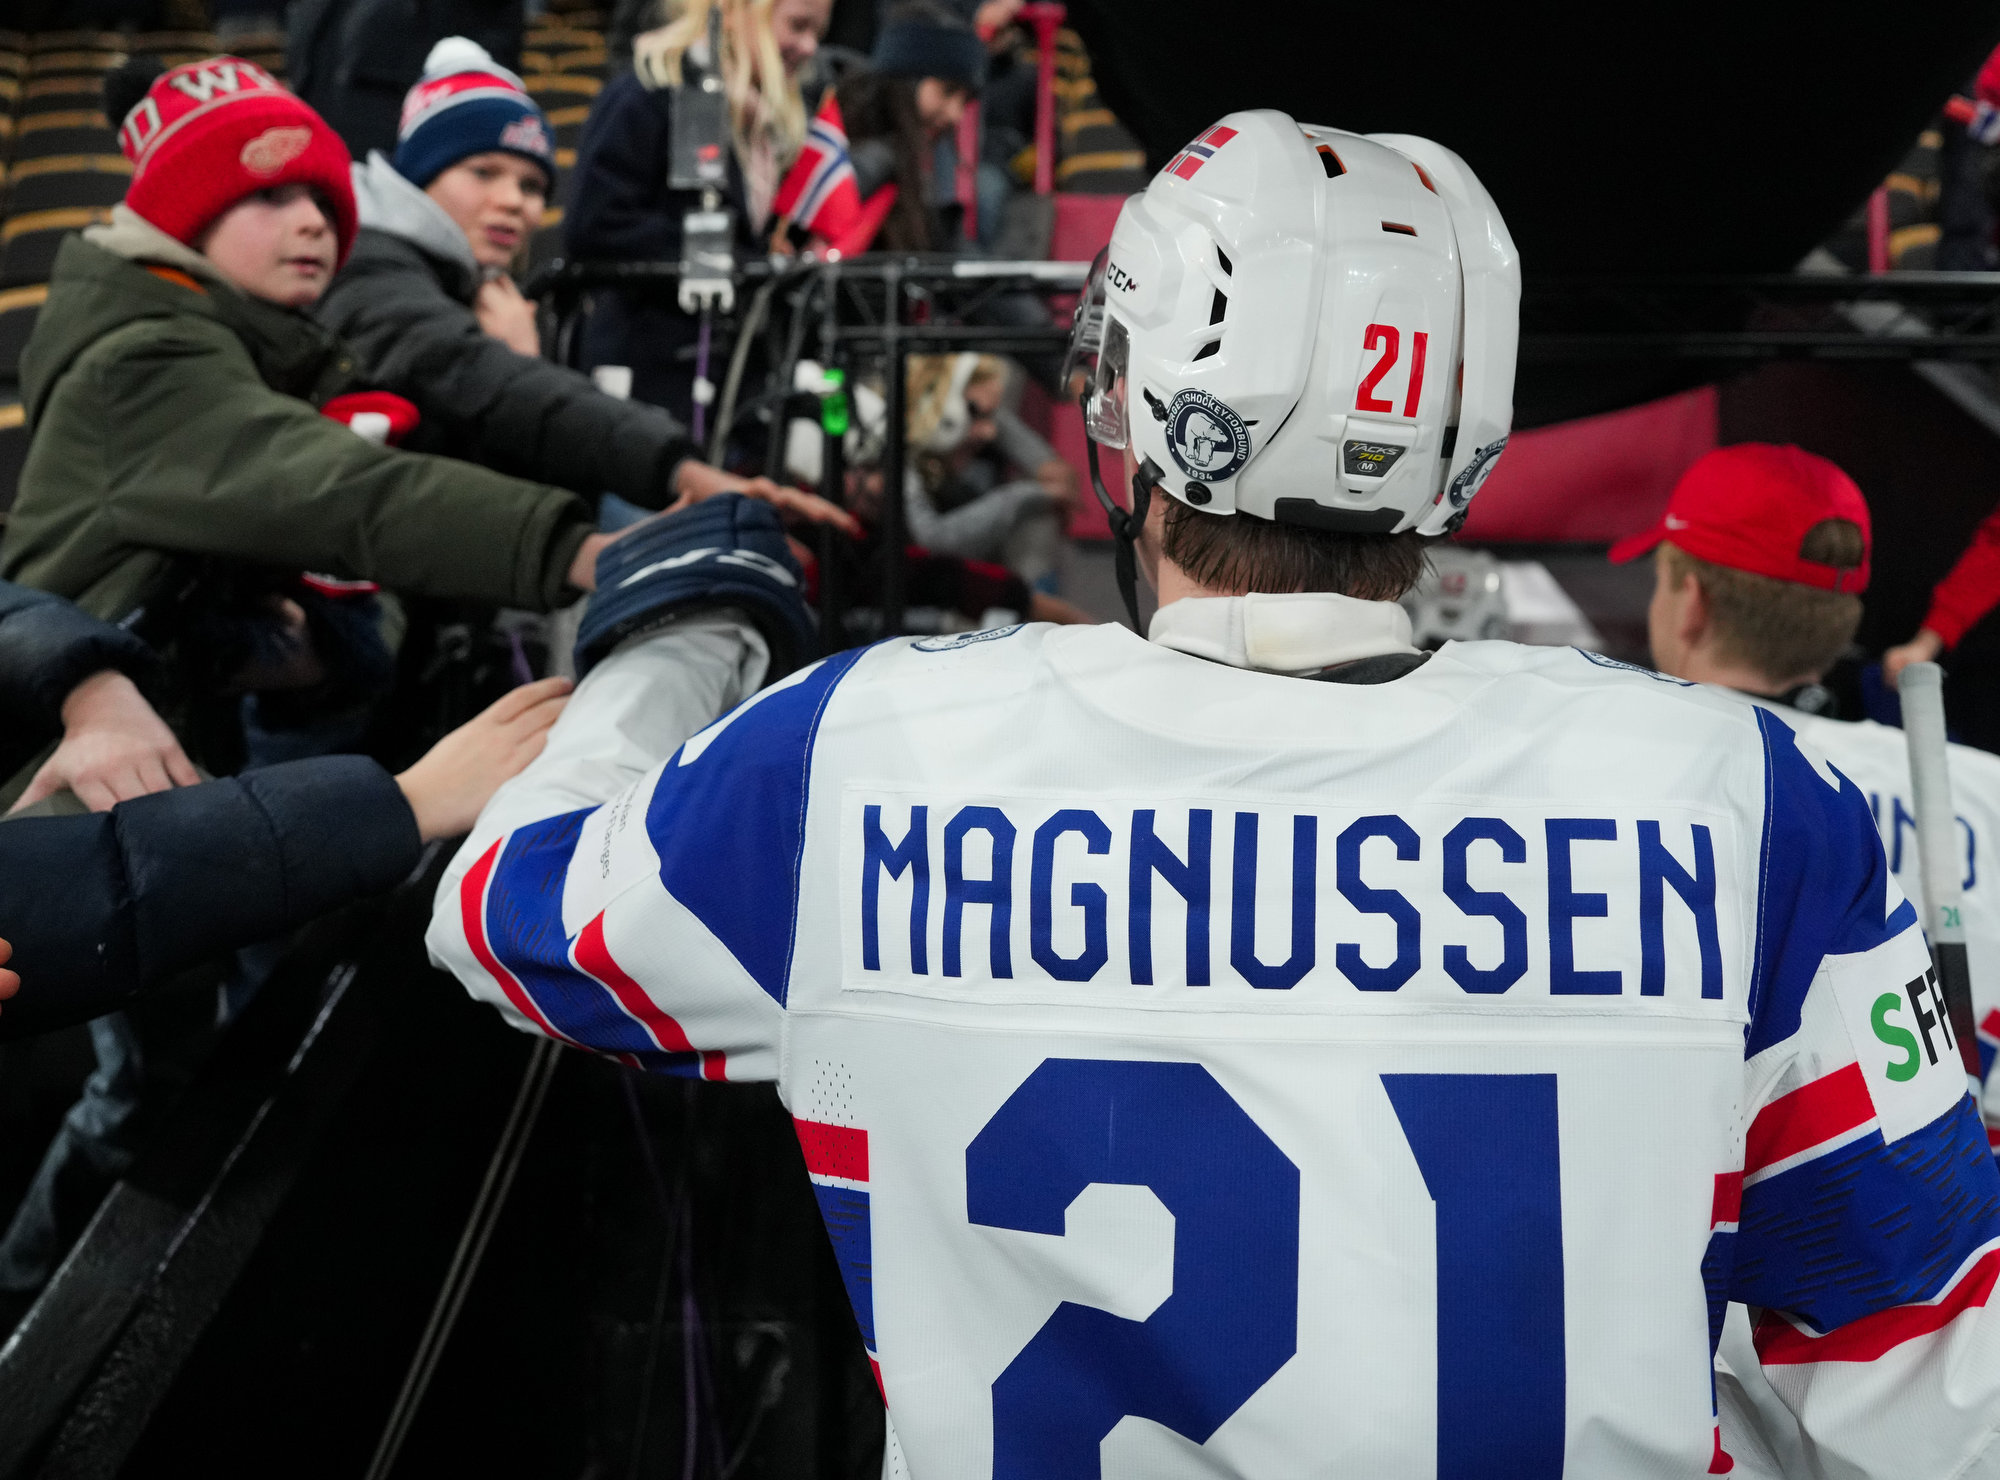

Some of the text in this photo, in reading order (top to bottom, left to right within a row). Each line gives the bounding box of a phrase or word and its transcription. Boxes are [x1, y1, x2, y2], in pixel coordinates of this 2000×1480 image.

[1107, 261, 1137, 292] CCM
[1355, 323, 1429, 418] 21
[1186, 466, 1213, 480] 1934
[1361, 462, 1374, 471] M
[862, 805, 1723, 999] MAGNUSSEN
[964, 1058, 1566, 1480] 21
